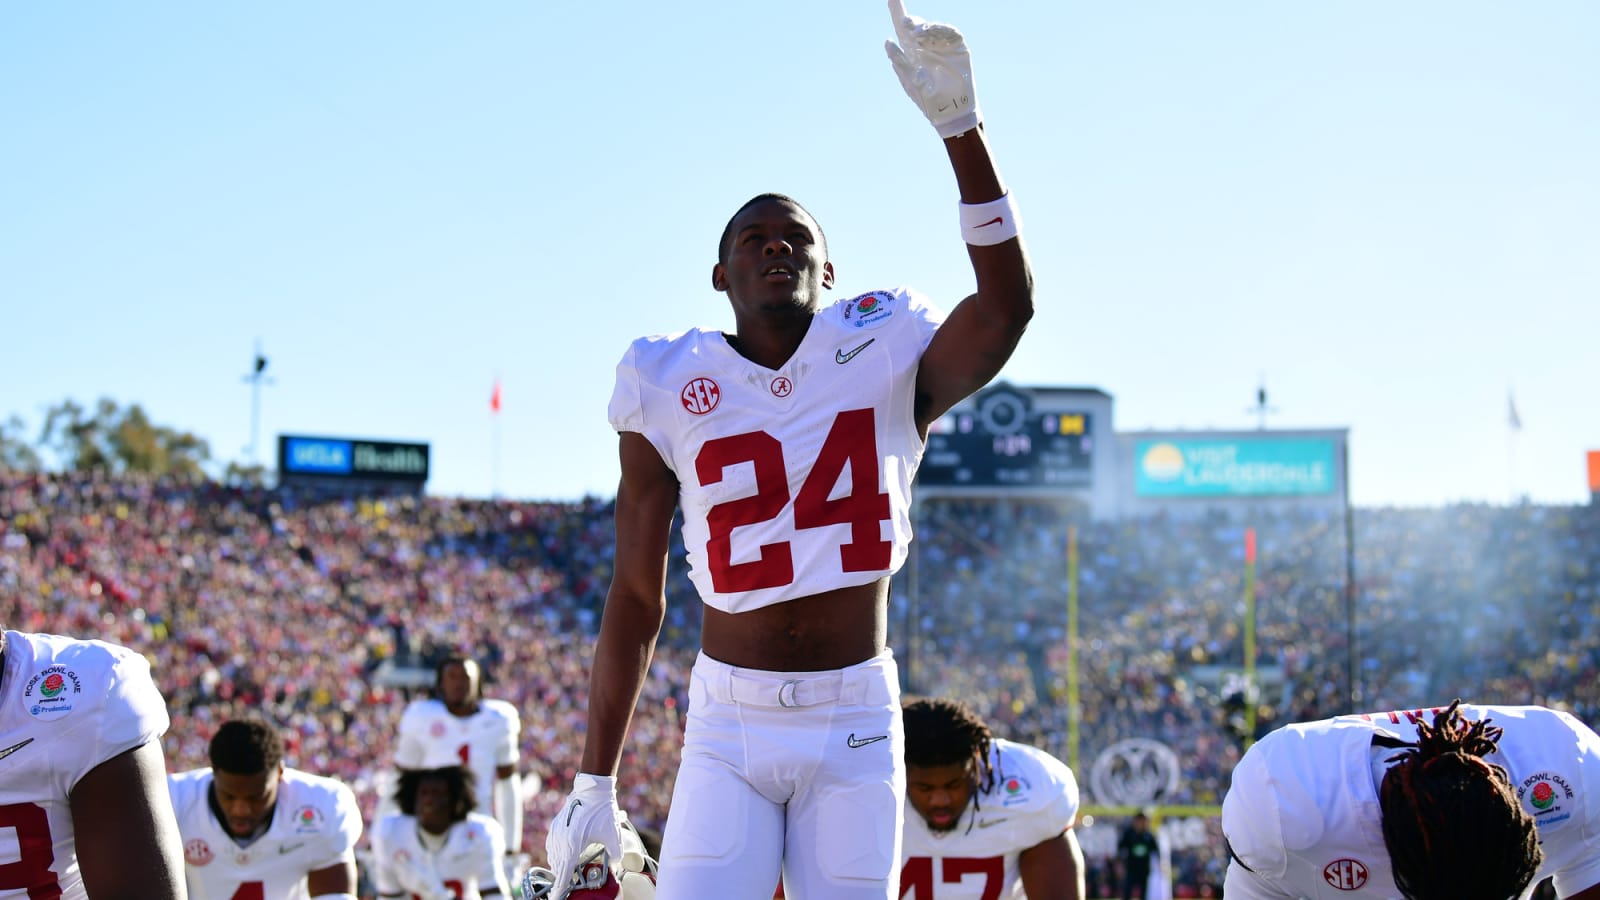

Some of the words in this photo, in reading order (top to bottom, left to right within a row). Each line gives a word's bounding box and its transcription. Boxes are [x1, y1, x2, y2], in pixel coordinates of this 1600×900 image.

[682, 378, 720, 415] SEC
[294, 444, 344, 467] UCLA
[354, 444, 426, 473] Health
[1186, 444, 1236, 463] VISIT
[1184, 460, 1325, 486] LAUDERDALE
[694, 407, 892, 593] 24
[25, 675, 40, 697] ROSE
[41, 666, 66, 677] BOWL
[67, 671, 81, 694] GAME
[41, 704, 72, 713] Prudential
[1524, 773, 1551, 788] BOWL
[1552, 775, 1574, 800] GAME
[1324, 859, 1368, 890] SEC
